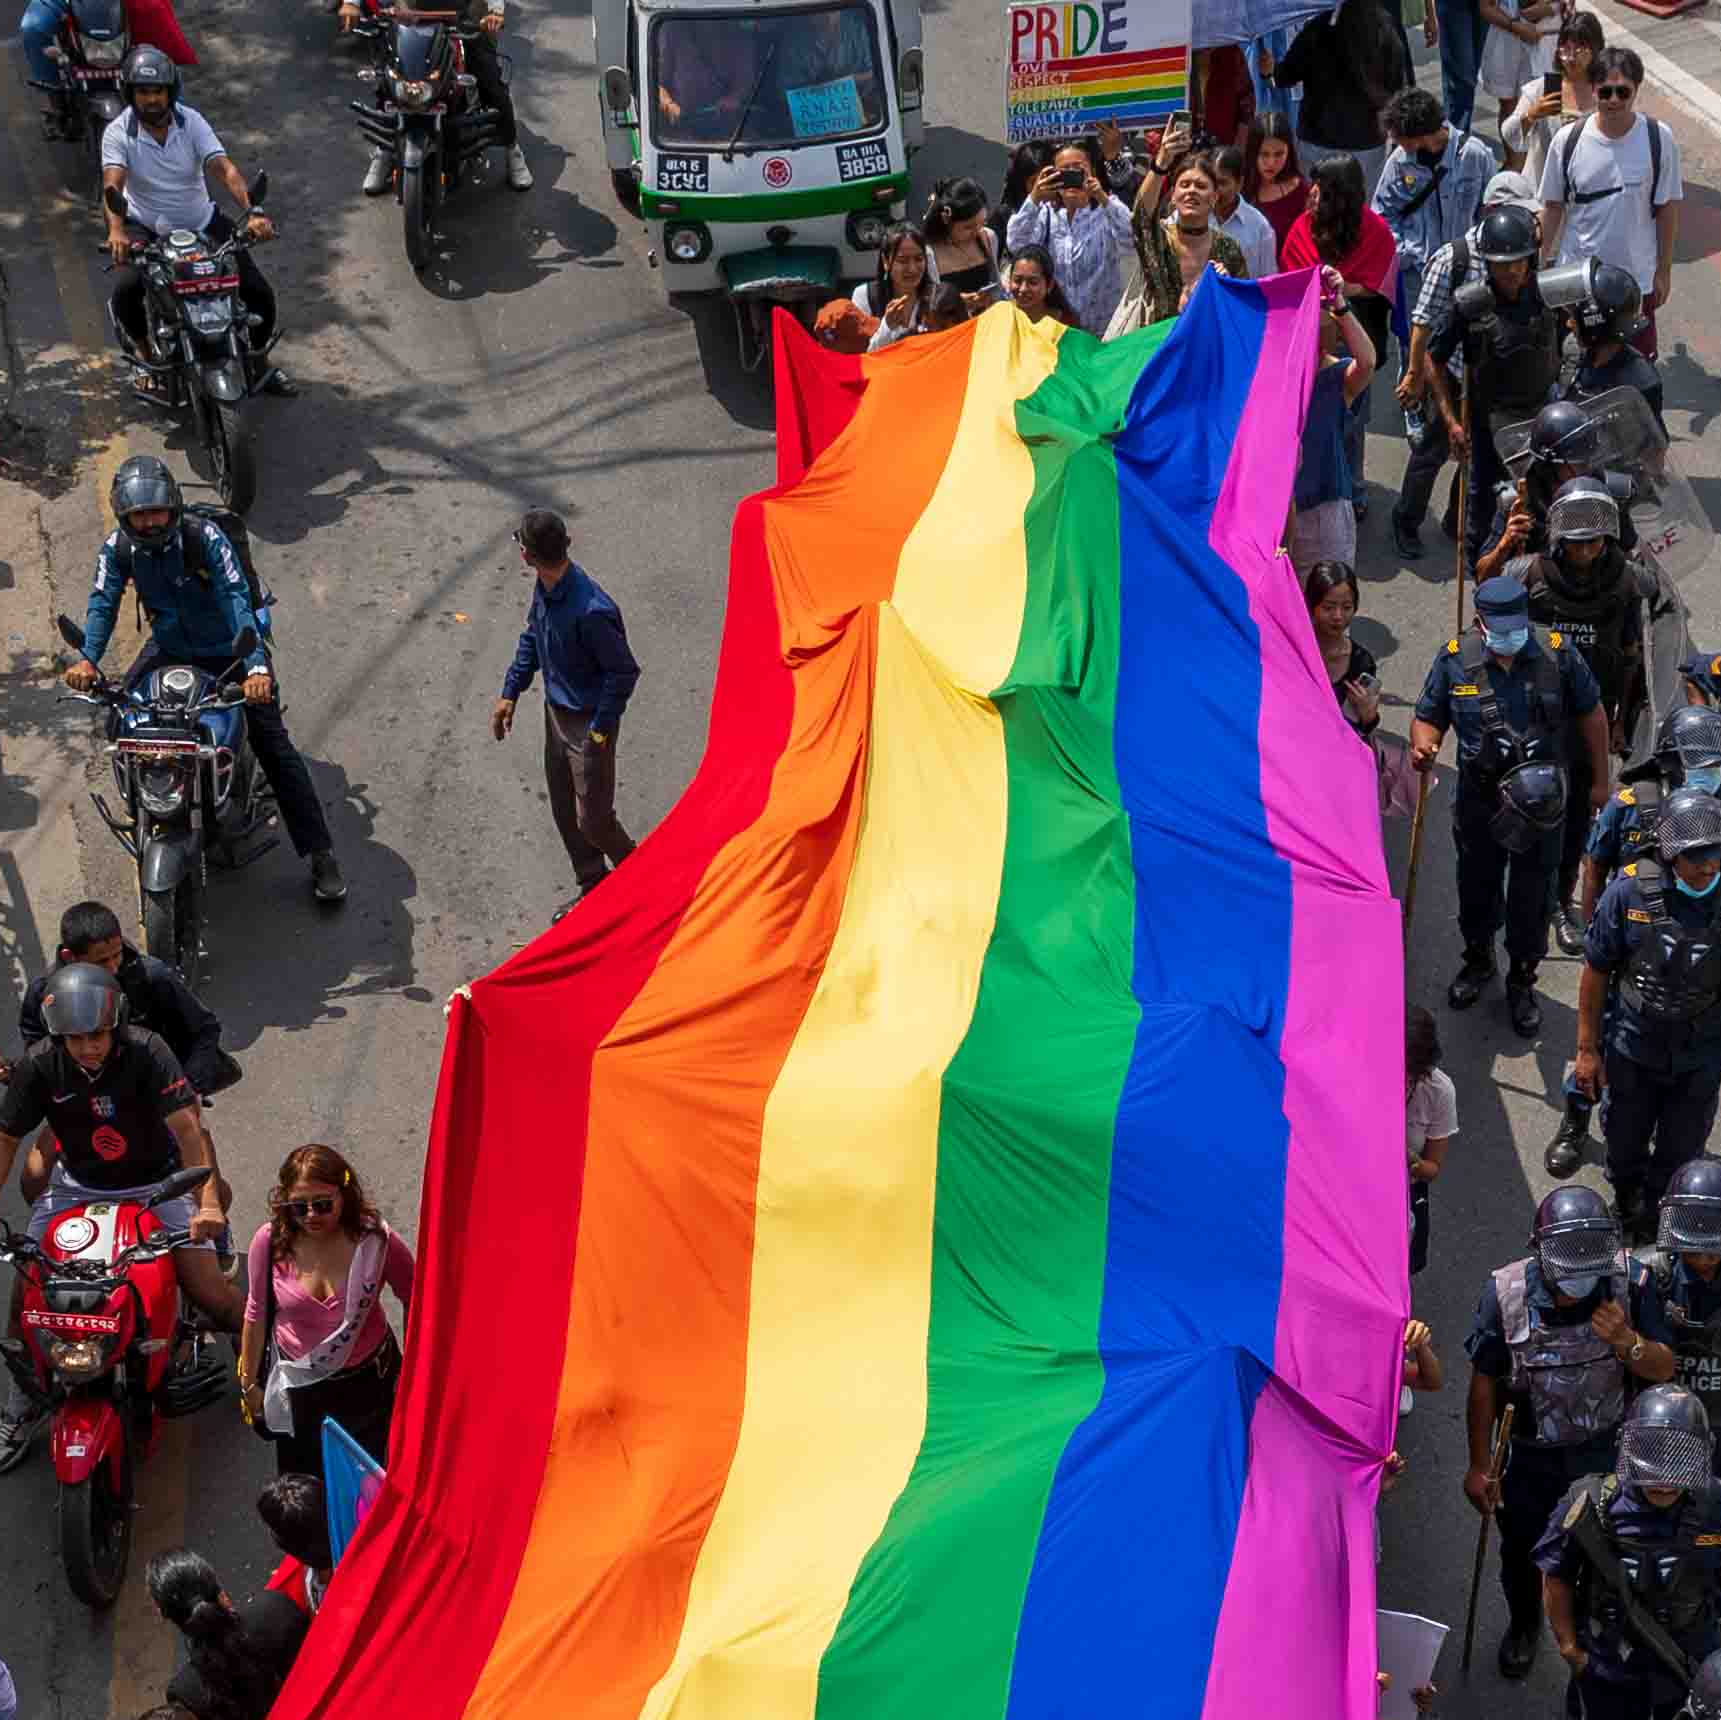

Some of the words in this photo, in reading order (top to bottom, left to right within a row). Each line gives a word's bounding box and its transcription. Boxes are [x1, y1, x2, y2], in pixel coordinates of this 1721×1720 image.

[1010, 0, 1128, 63] PRIDE
[1010, 62, 1048, 74] LOVE
[1009, 73, 1070, 89] RESPECT
[1009, 97, 1083, 115] TOLERANCE
[1009, 110, 1078, 128] EQUALITY
[1008, 121, 1087, 143] DIVERSITY
[840, 154, 889, 179] 3858
